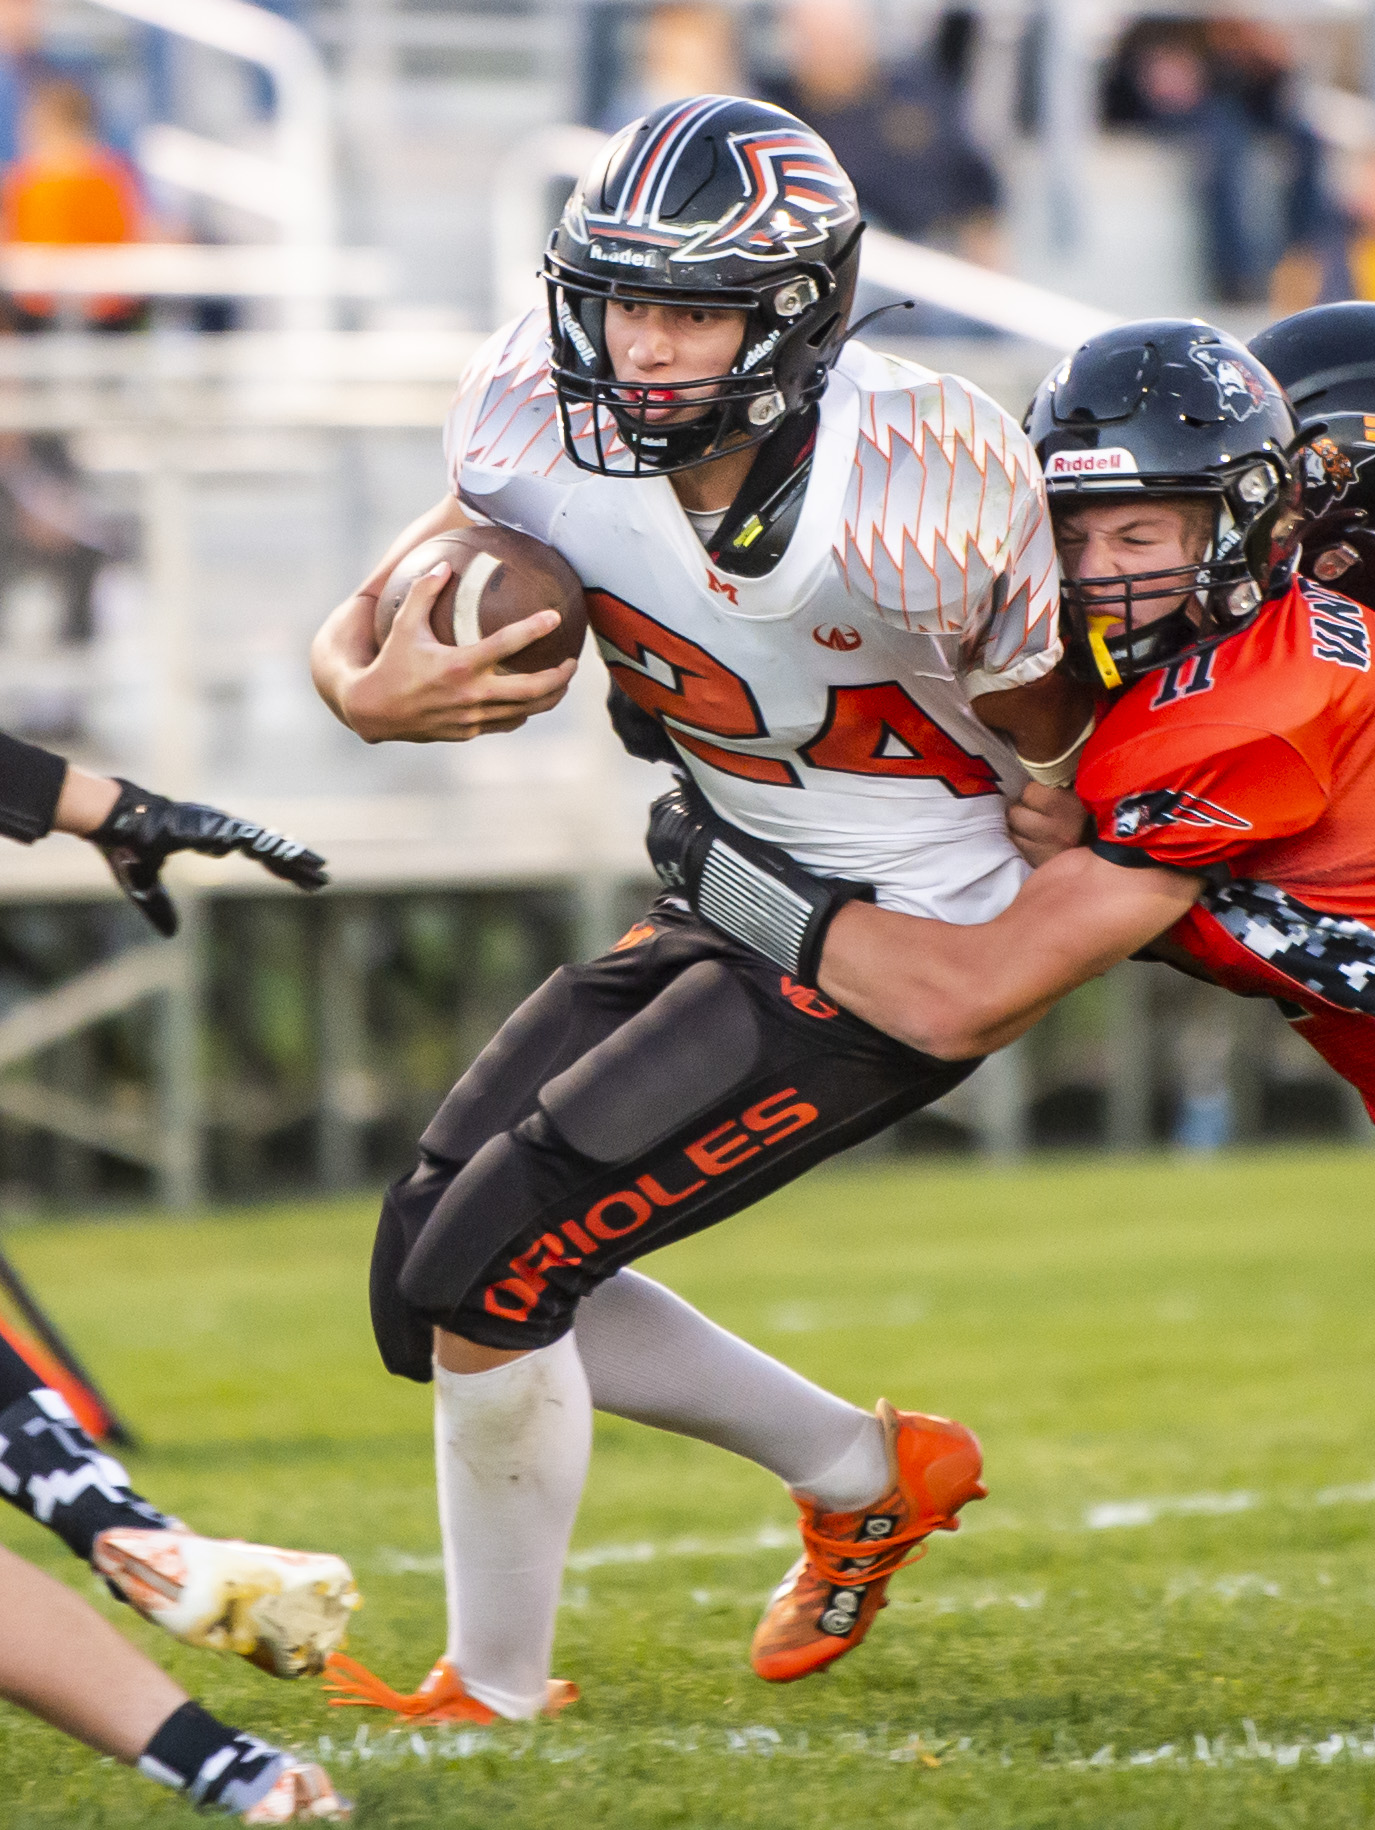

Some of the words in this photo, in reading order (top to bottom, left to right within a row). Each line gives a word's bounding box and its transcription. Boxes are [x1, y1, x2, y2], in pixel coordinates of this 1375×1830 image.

[1054, 454, 1121, 472] Riddell
[583, 586, 1004, 799] 24
[484, 1087, 819, 1322] ORIOLES
